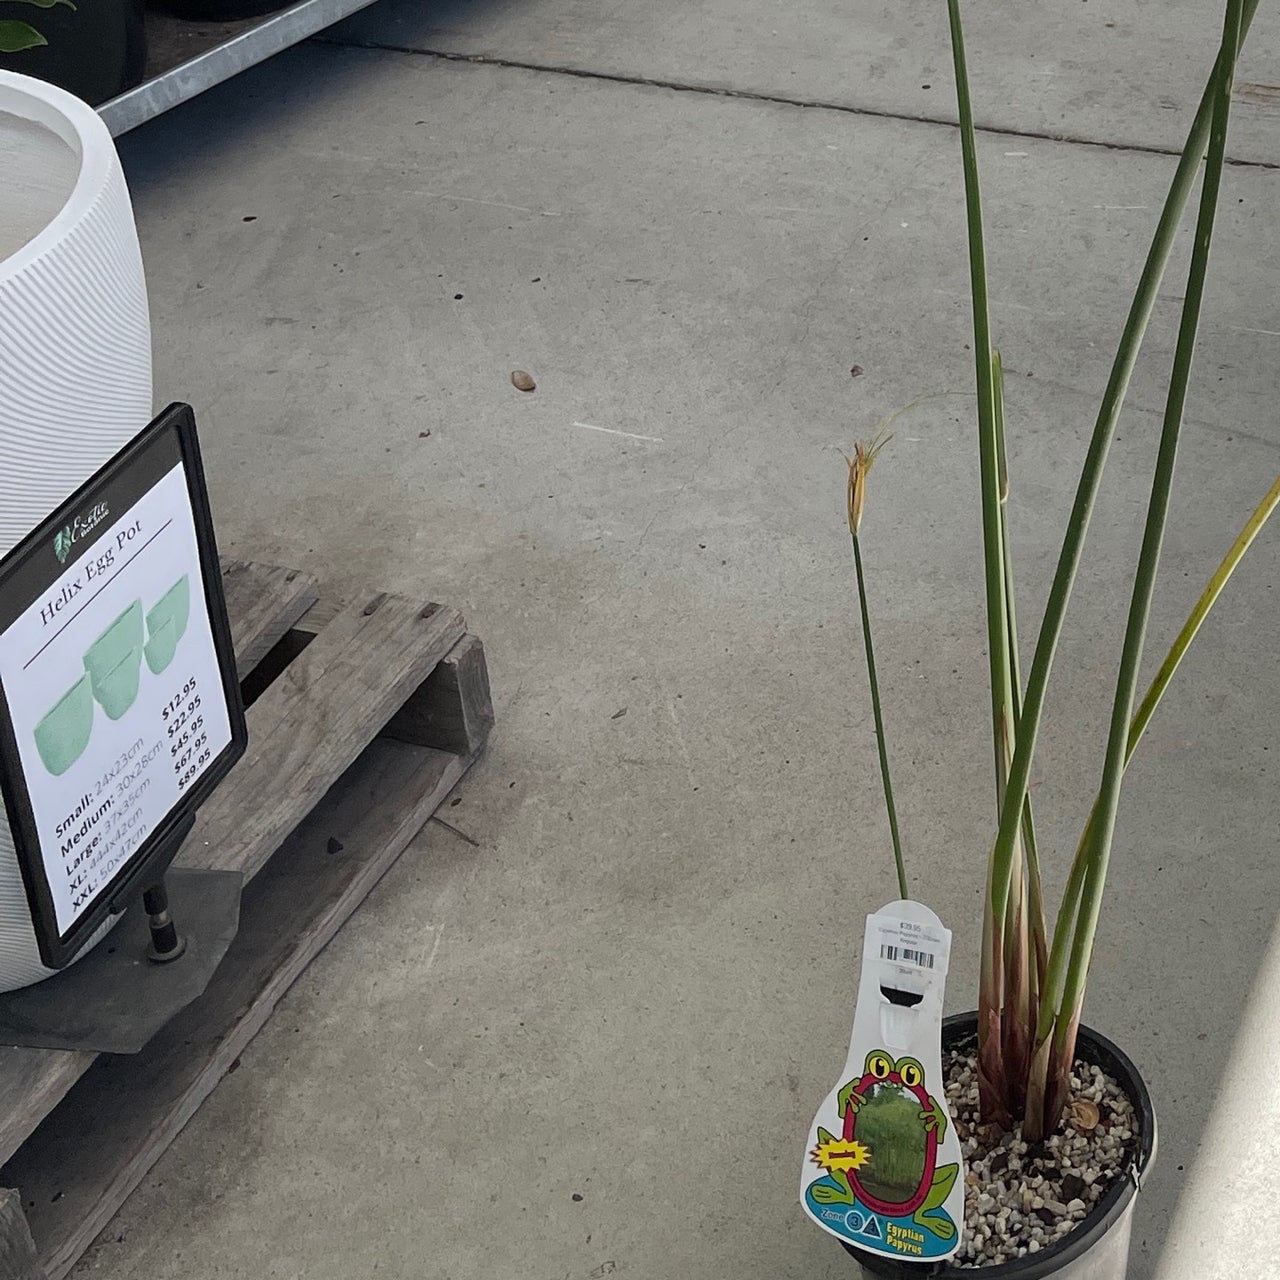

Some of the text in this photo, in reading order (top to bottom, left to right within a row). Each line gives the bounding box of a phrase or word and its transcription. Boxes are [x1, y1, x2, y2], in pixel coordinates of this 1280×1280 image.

[40, 520, 143, 627] Helix Egg Pot
[71, 501, 108, 543] Exotic
[56, 677, 197, 839] Small: 24x23cm $12.95
[61, 695, 201, 858] Medium: 30x28cm $22.95
[65, 715, 204, 876] Large: 37x35cm $45.95
[69, 869, 88, 895] XL:
[174, 732, 208, 775] $67.95
[72, 748, 212, 912] XXL: 50x47cm $89.95
[821, 1208, 845, 1223] Zone
[850, 1215, 860, 1227] 3
[886, 1222, 925, 1243] Egyptian
[886, 1235, 922, 1255] Papyrus
